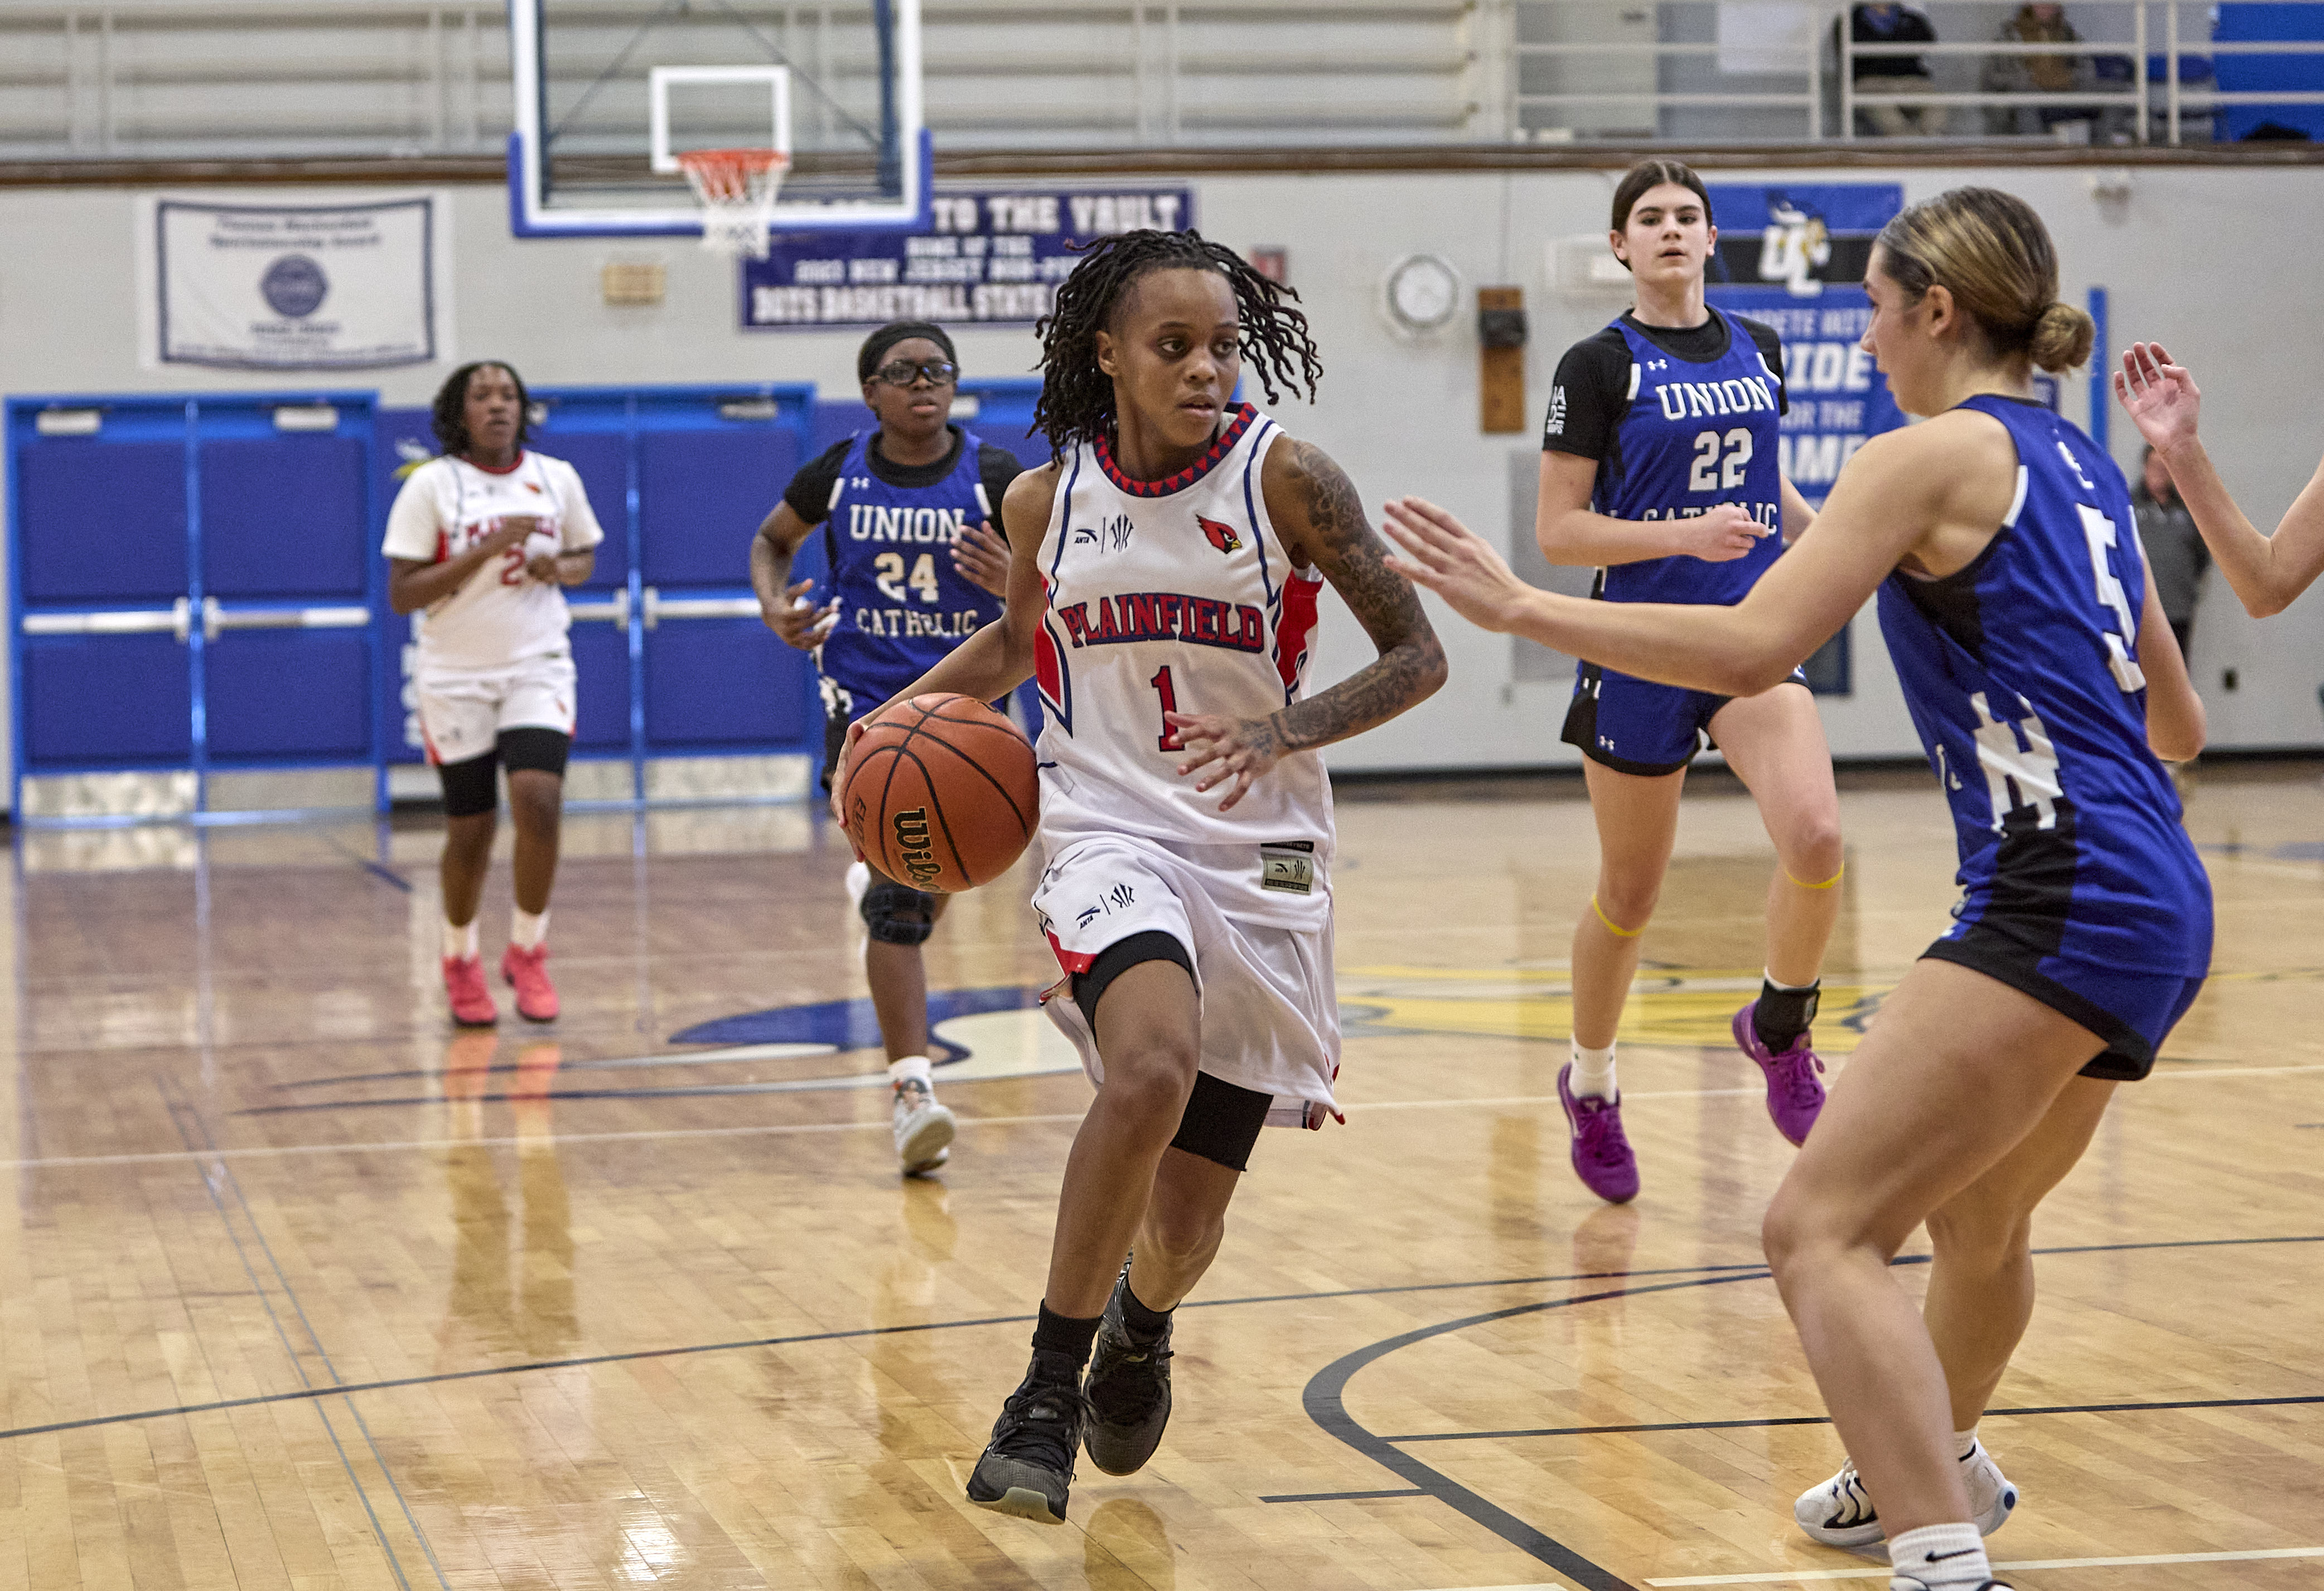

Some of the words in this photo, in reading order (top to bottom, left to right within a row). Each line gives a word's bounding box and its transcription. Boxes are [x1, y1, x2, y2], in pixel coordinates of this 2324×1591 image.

[989, 196, 1058, 233] THE
[1070, 195, 1180, 234] VAULT
[820, 284, 972, 321] BASKETBALL
[973, 283, 1049, 319] STATE
[1781, 343, 1872, 390] IDE
[1655, 375, 1775, 421] UNION
[1688, 427, 1753, 491] 22
[849, 504, 965, 543] UNION
[873, 552, 939, 604] 24
[2075, 502, 2147, 693] 5
[856, 608, 978, 639] CATHOLIC
[1057, 592, 1264, 654] PLAINFIELD
[1150, 665, 1186, 752] 1
